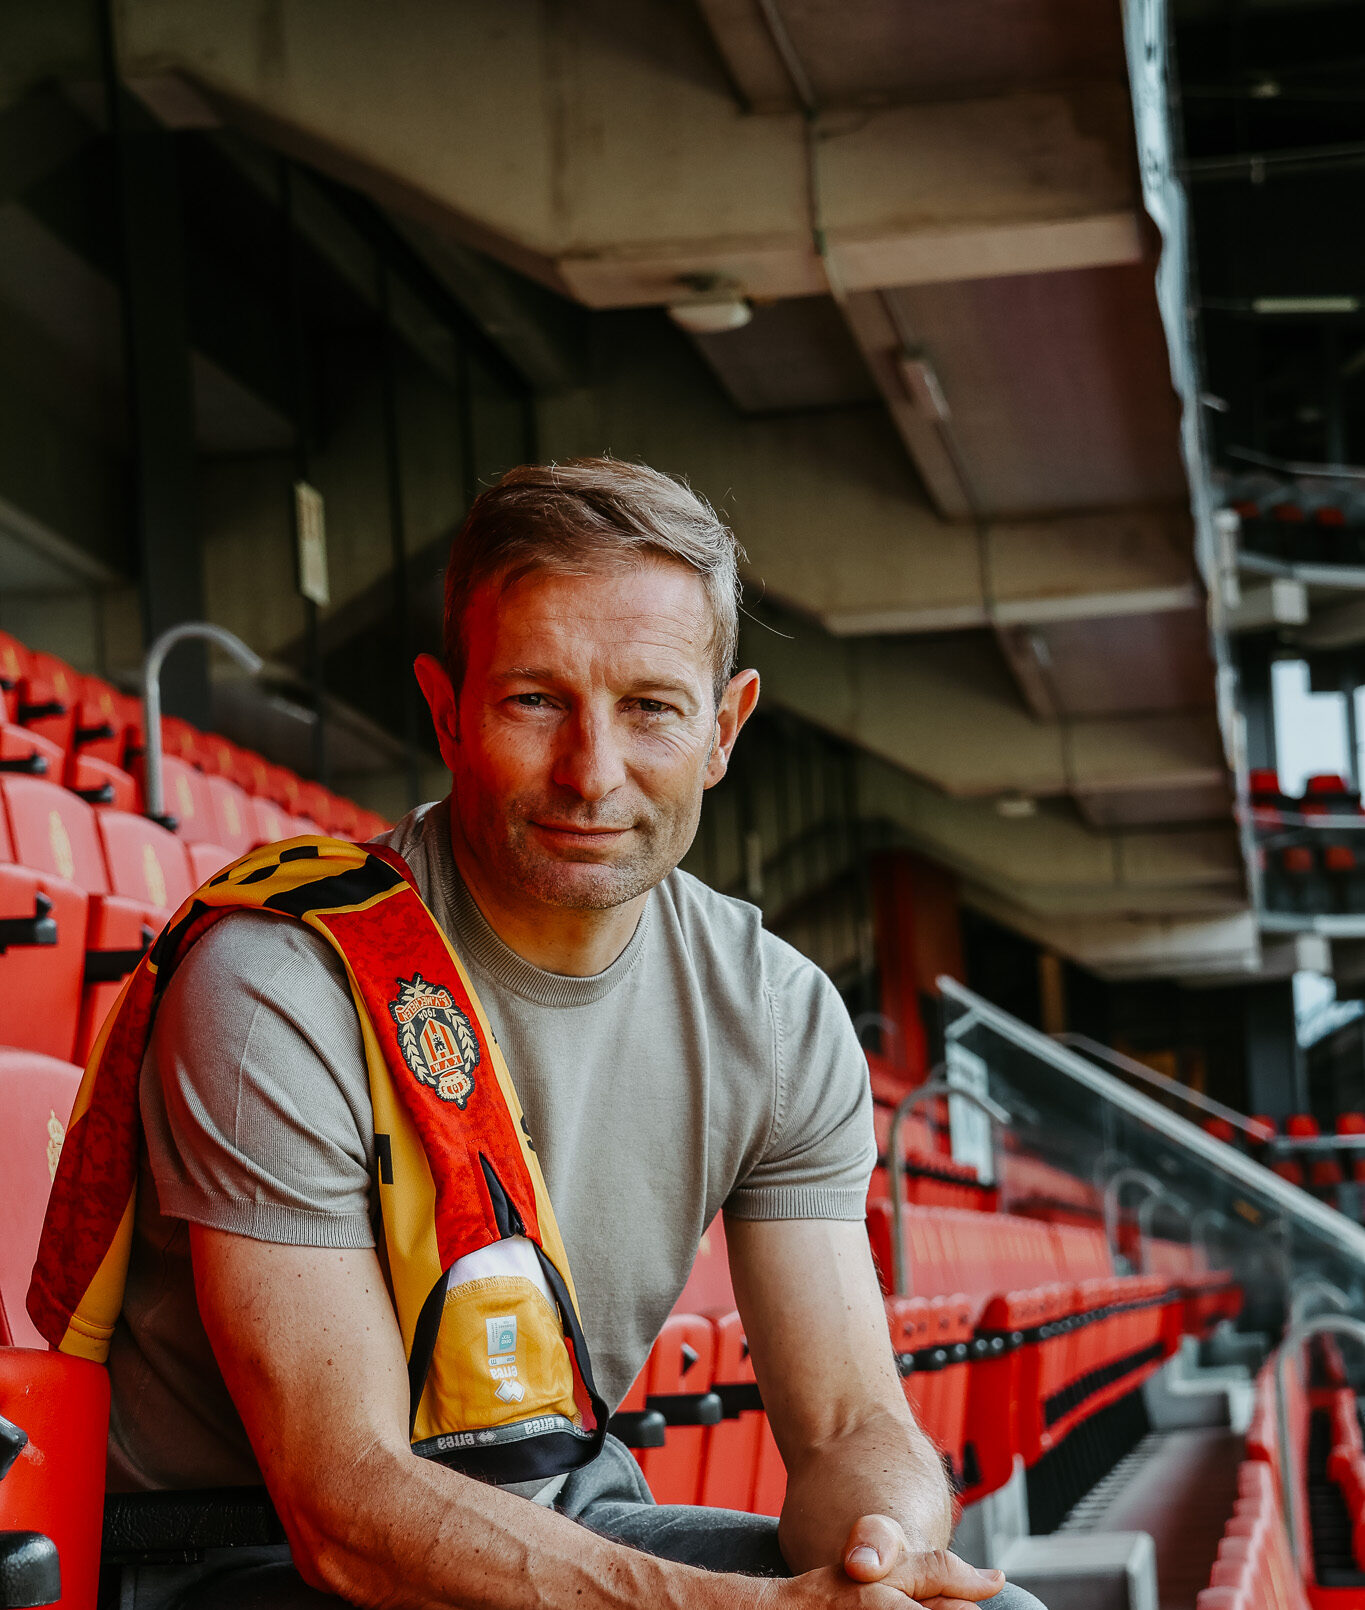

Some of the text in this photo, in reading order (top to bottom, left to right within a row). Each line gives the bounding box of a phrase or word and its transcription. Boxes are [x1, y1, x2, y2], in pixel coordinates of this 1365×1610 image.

[418, 1008, 437, 1021] 1904
[489, 1365, 518, 1380] errea
[524, 1417, 556, 1435] errea
[437, 1433, 475, 1450] errea
